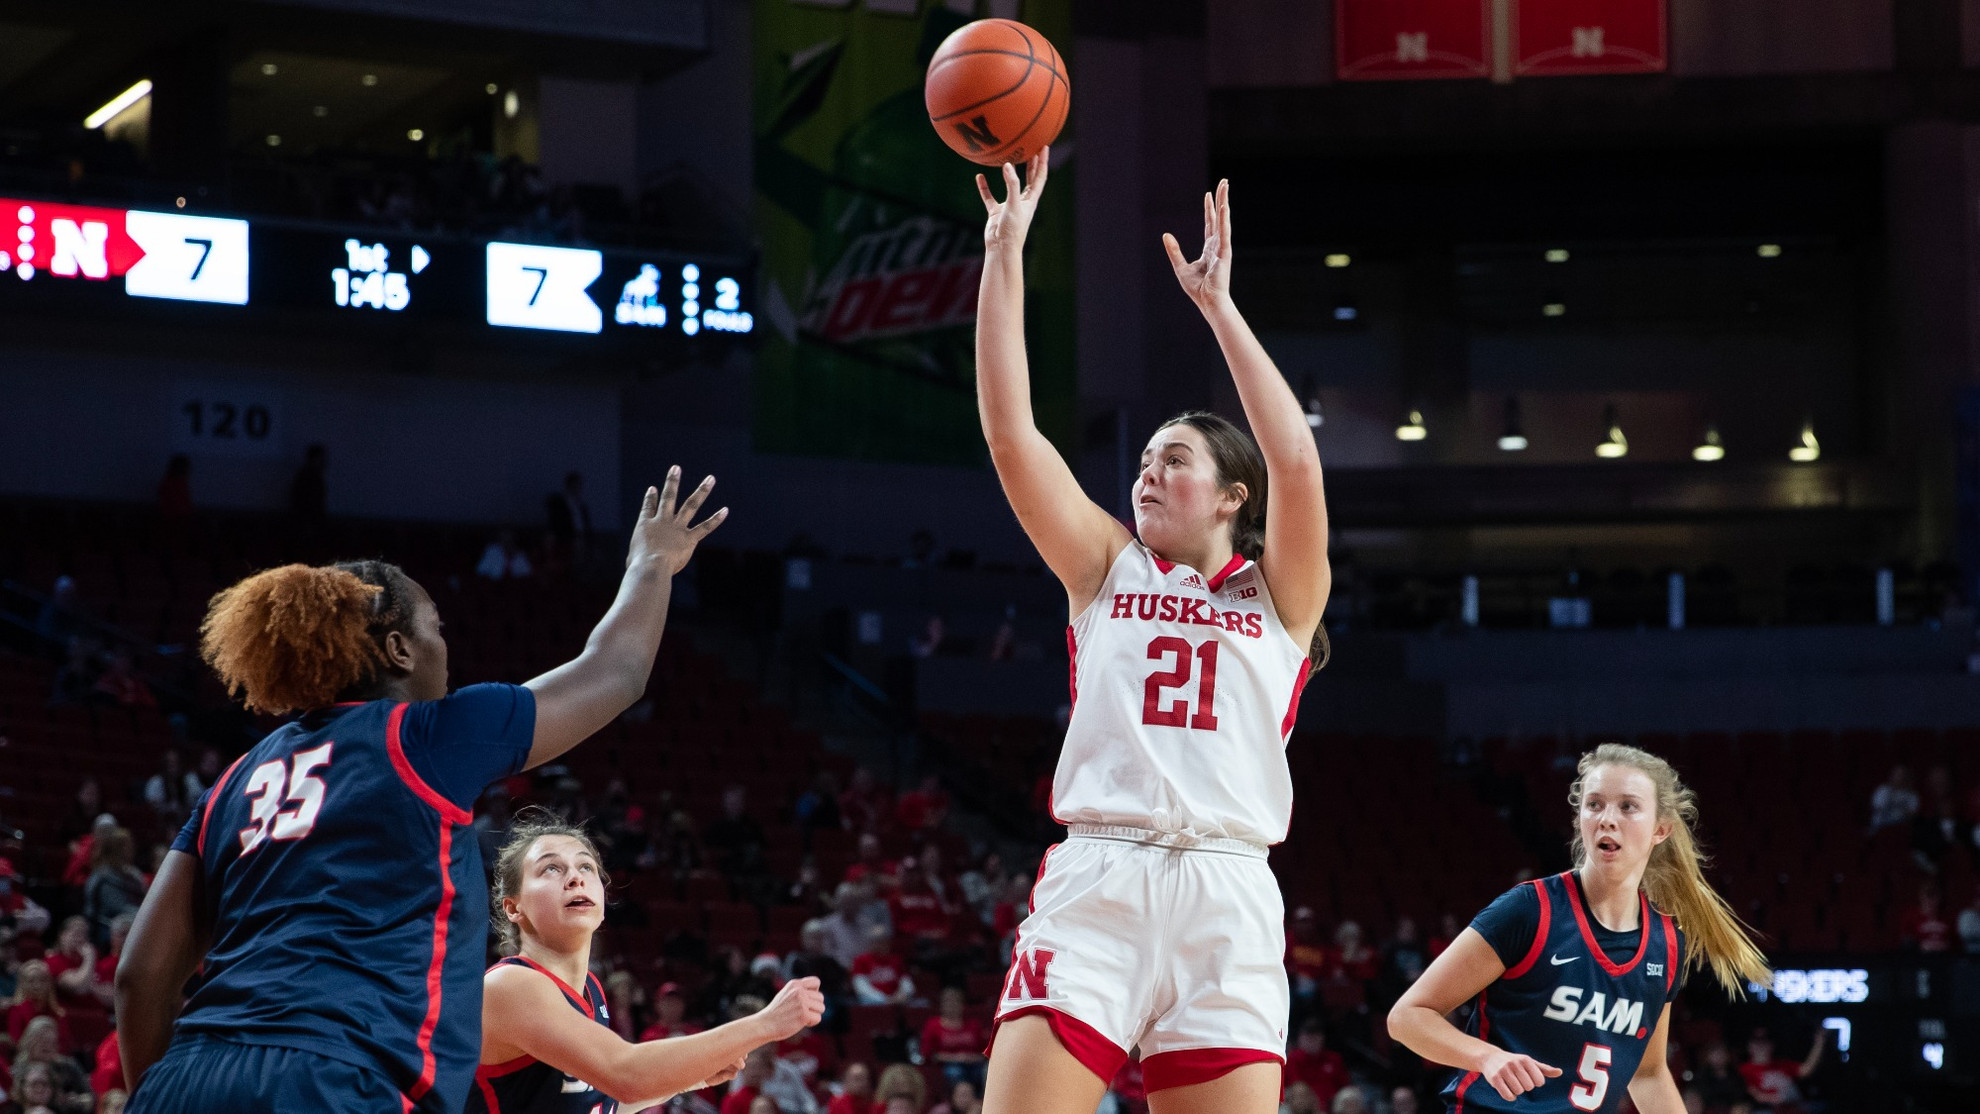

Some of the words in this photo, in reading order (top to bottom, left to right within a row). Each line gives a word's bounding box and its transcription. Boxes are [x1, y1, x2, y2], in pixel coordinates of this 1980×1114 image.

[955, 115, 1001, 152] N
[50, 218, 109, 279] N
[184, 238, 213, 281] 7
[332, 268, 411, 311] 1:45
[522, 266, 548, 306] 7
[716, 278, 739, 310] 2
[182, 401, 270, 440] 120
[1179, 580, 1205, 591] adidas
[1110, 593, 1263, 639] HUSKERS
[1141, 635, 1220, 732] 21
[239, 741, 334, 858] 35
[1008, 945, 1058, 1001] N
[1568, 1042, 1613, 1113] 5
